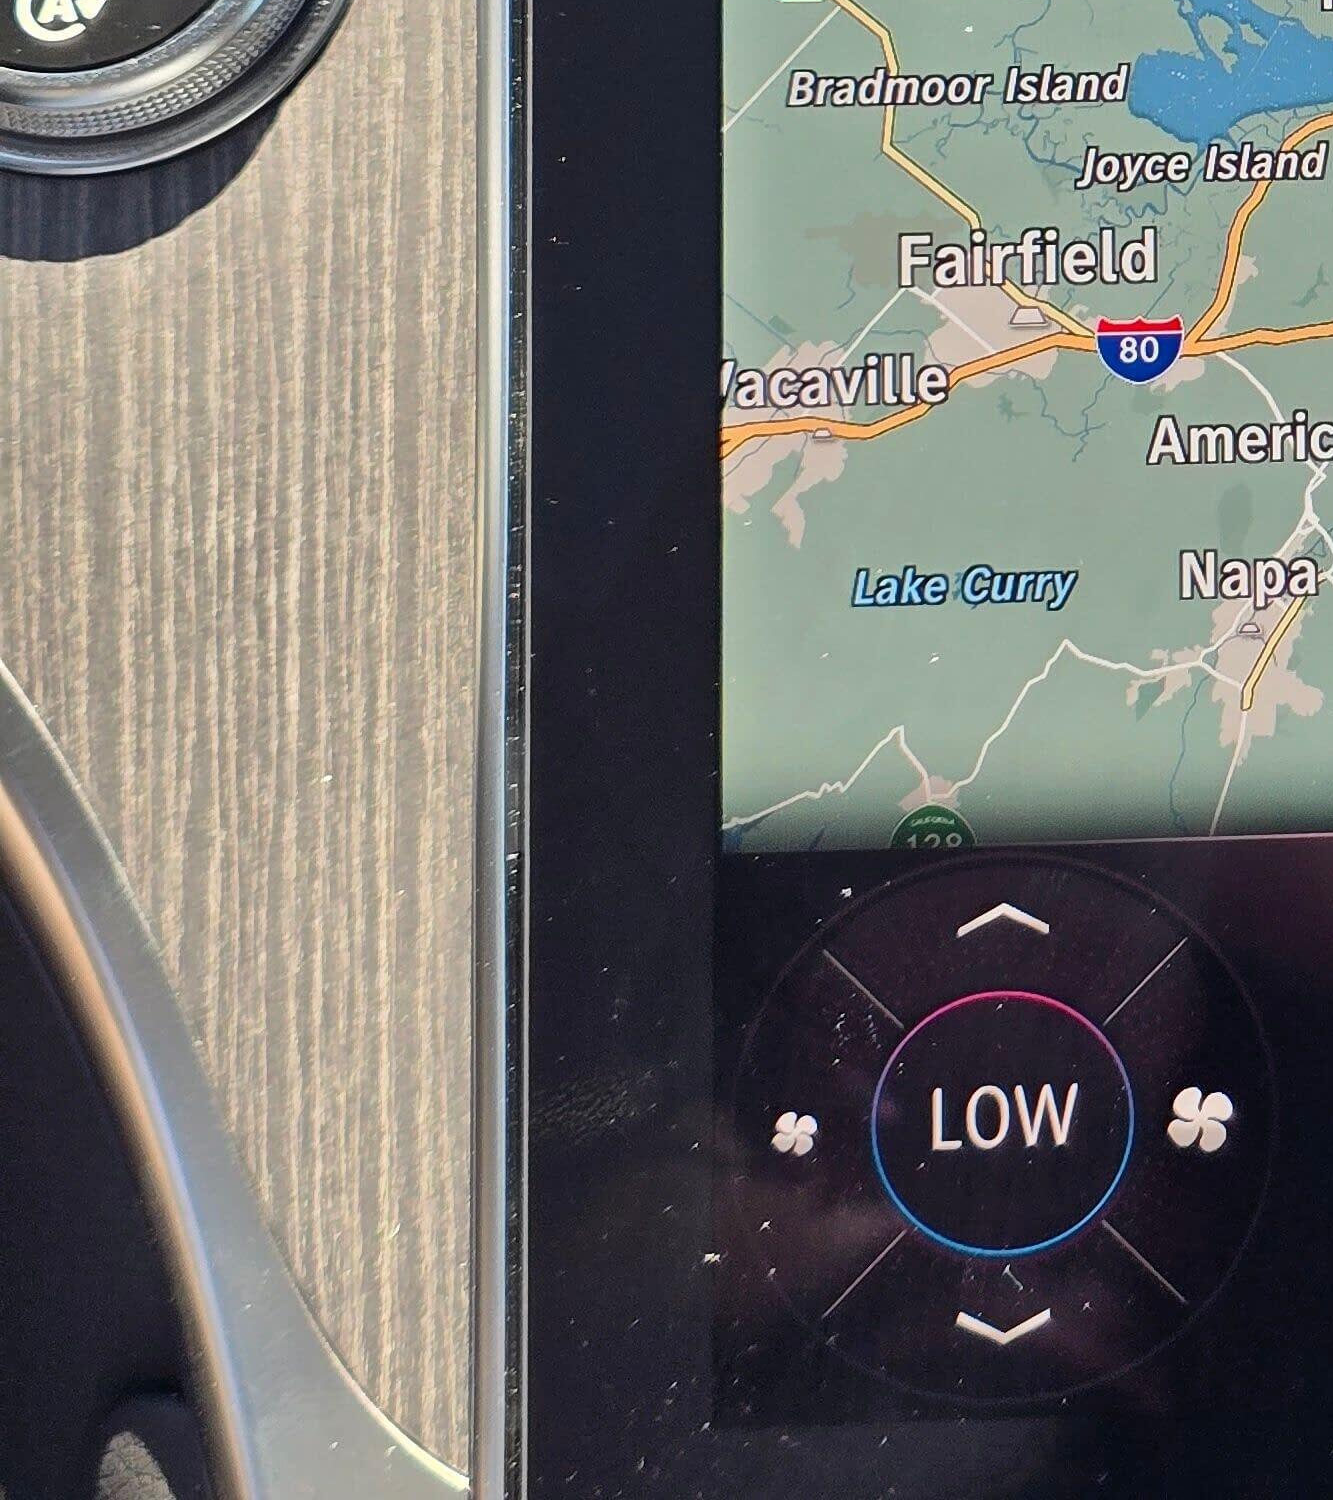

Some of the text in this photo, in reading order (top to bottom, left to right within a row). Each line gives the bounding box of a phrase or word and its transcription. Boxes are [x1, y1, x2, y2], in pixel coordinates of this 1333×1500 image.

[787, 64, 1130, 107] Bradmoor Island
[1075, 142, 1328, 191] Joyce Island
[899, 228, 1159, 288] Fairfield
[1118, 335, 1160, 365] 80
[852, 566, 1078, 611] Lake Curry
[1180, 550, 1320, 607] Napa
[931, 1082, 1080, 1151] LOW
